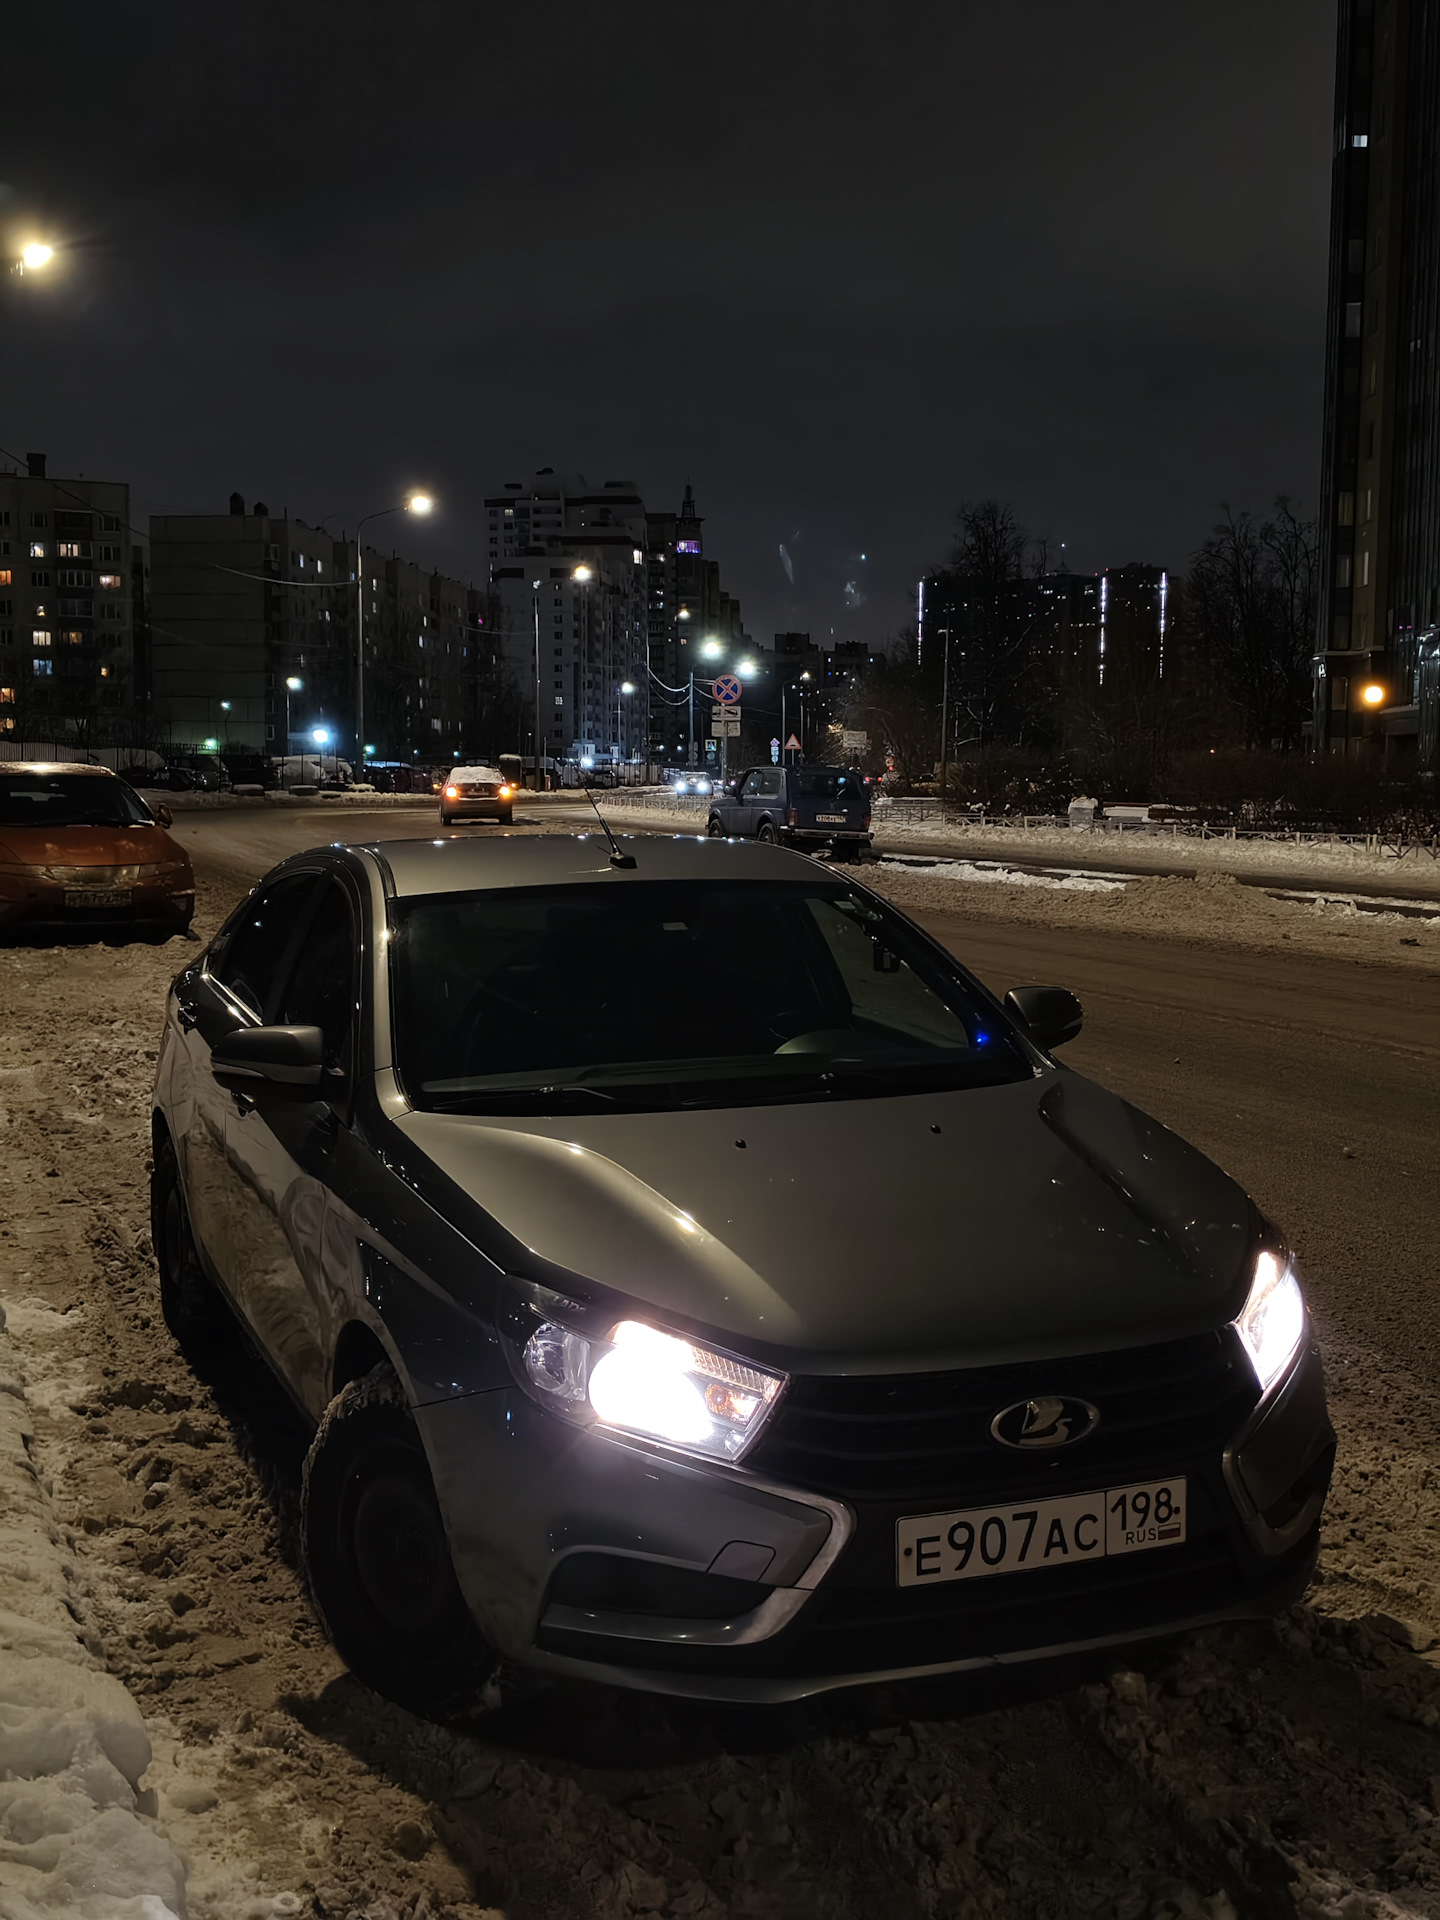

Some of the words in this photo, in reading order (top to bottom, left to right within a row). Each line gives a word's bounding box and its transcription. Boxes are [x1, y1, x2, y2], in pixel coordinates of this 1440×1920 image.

[915, 1511, 1099, 1576] Е907АС
[1110, 1487, 1173, 1531] 198
[1125, 1529, 1157, 1545] RUS
